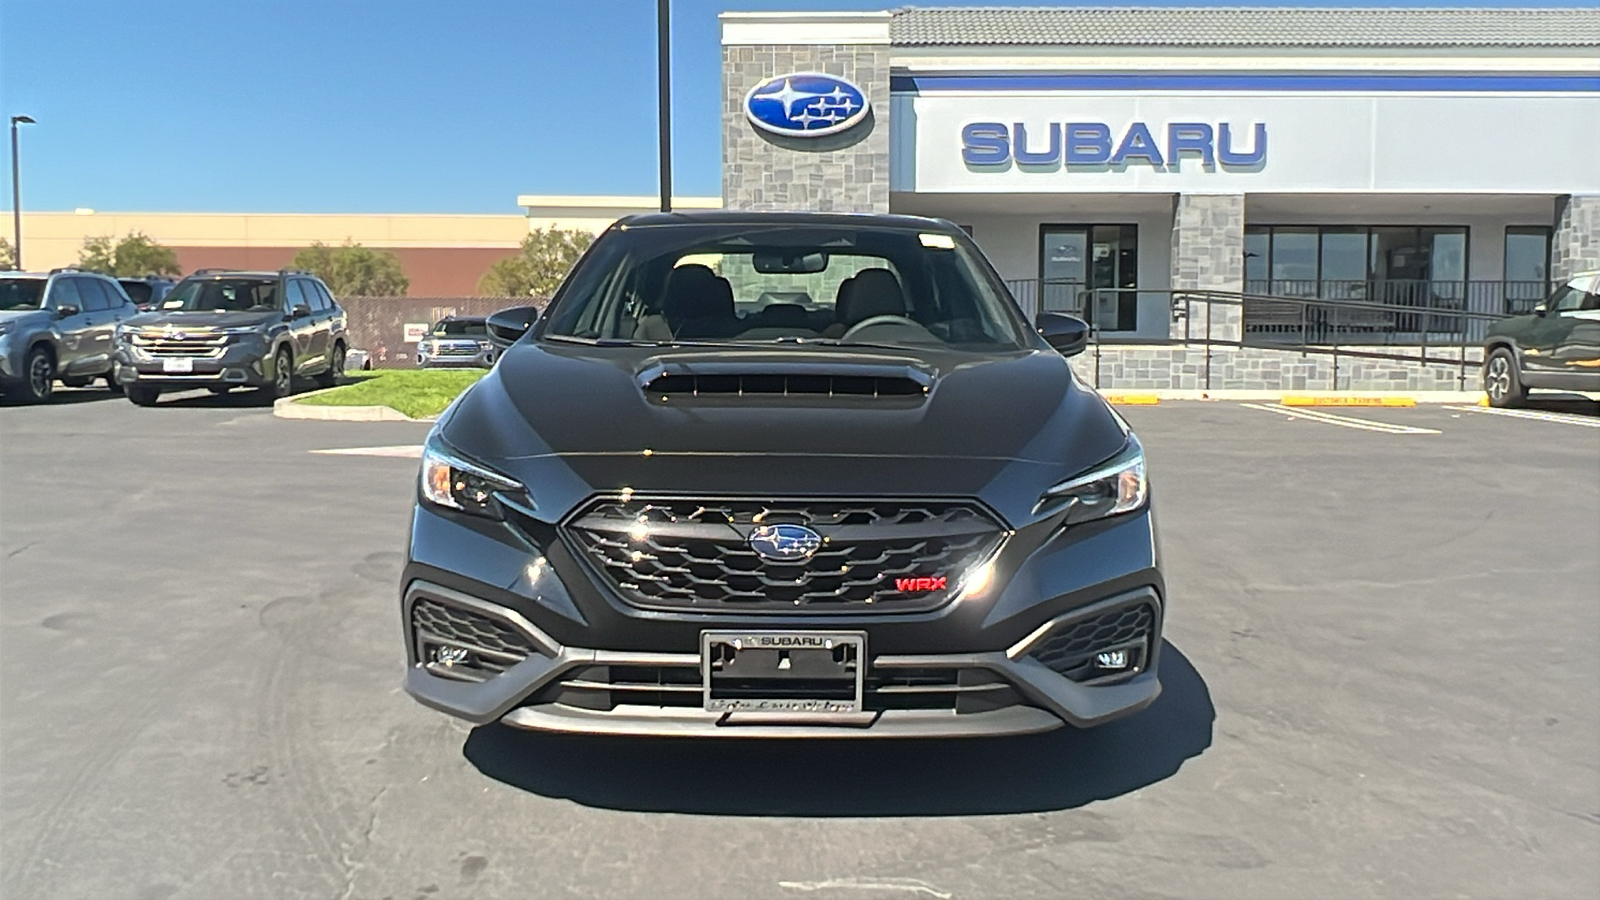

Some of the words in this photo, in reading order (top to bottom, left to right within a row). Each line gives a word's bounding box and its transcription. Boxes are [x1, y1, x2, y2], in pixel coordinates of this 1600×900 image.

[961, 122, 1267, 166] SUBARU
[895, 576, 947, 591] WRX
[760, 636, 823, 646] SUBARU
